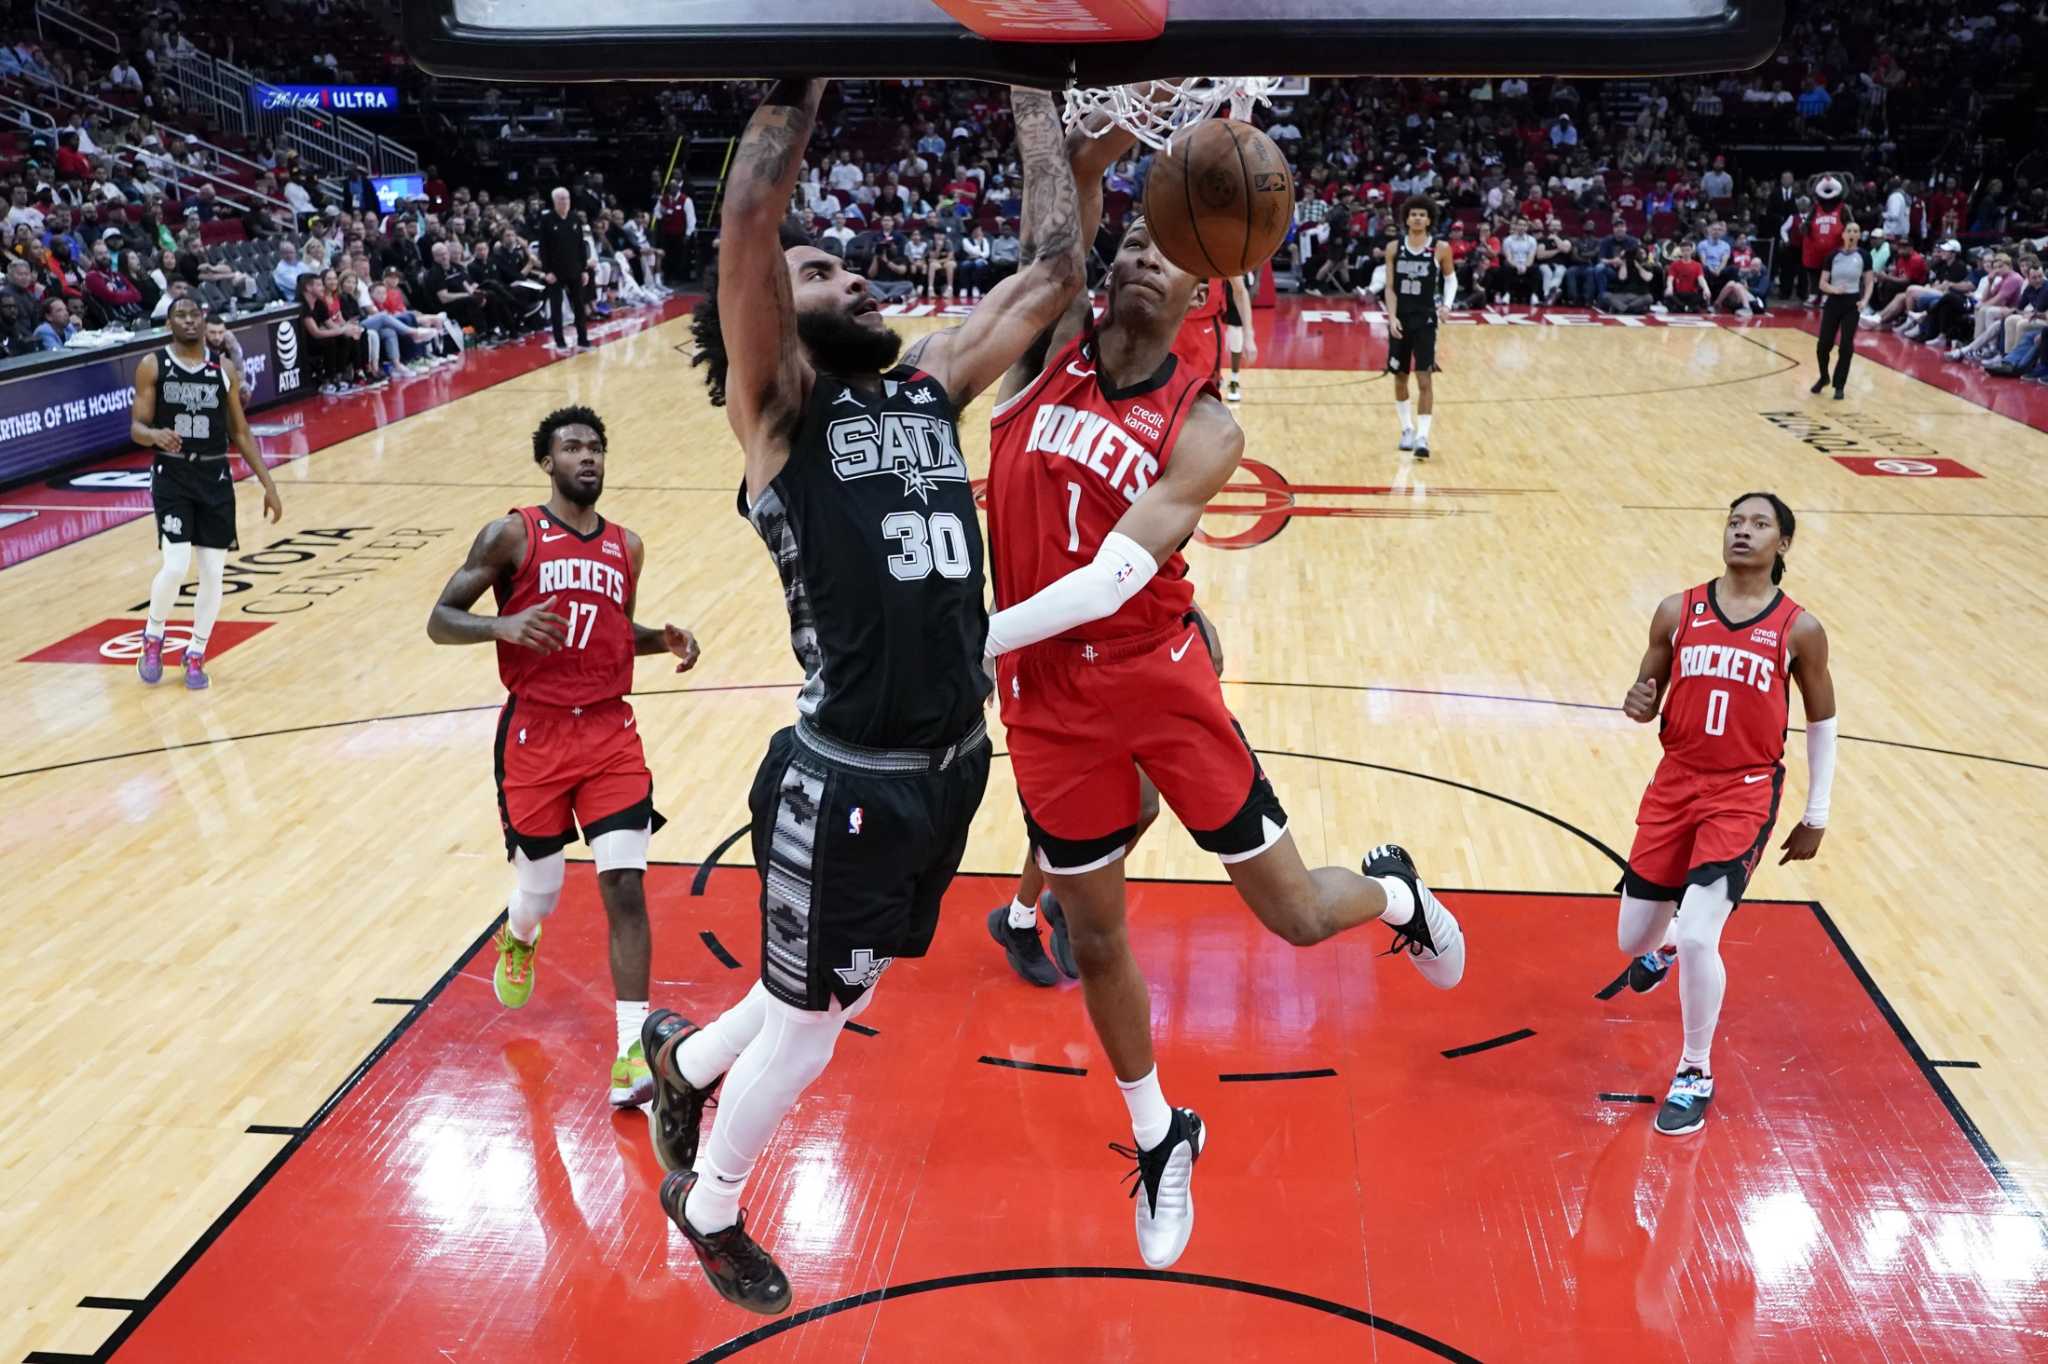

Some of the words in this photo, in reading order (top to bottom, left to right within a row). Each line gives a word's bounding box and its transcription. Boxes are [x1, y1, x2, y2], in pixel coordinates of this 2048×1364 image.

[332, 91, 388, 108] ULTRA
[279, 367, 300, 393] AT&T
[44, 404, 62, 428] OF
[63, 399, 87, 424] THE
[89, 385, 136, 417] HOUSTO
[1123, 413, 1160, 440] karma
[1132, 404, 1164, 428] credit
[826, 411, 967, 483] SATX
[1025, 404, 1159, 503] ROCKETS
[1067, 481, 1082, 552] 1
[881, 511, 971, 581] 30
[241, 527, 454, 614] CENTER
[539, 558, 624, 605] ROCKETS
[564, 600, 598, 650] 17
[1750, 635, 1778, 648] karma
[1754, 628, 1778, 639] credit
[1680, 645, 1776, 693] ROCKETS
[1704, 689, 1730, 737] 0
